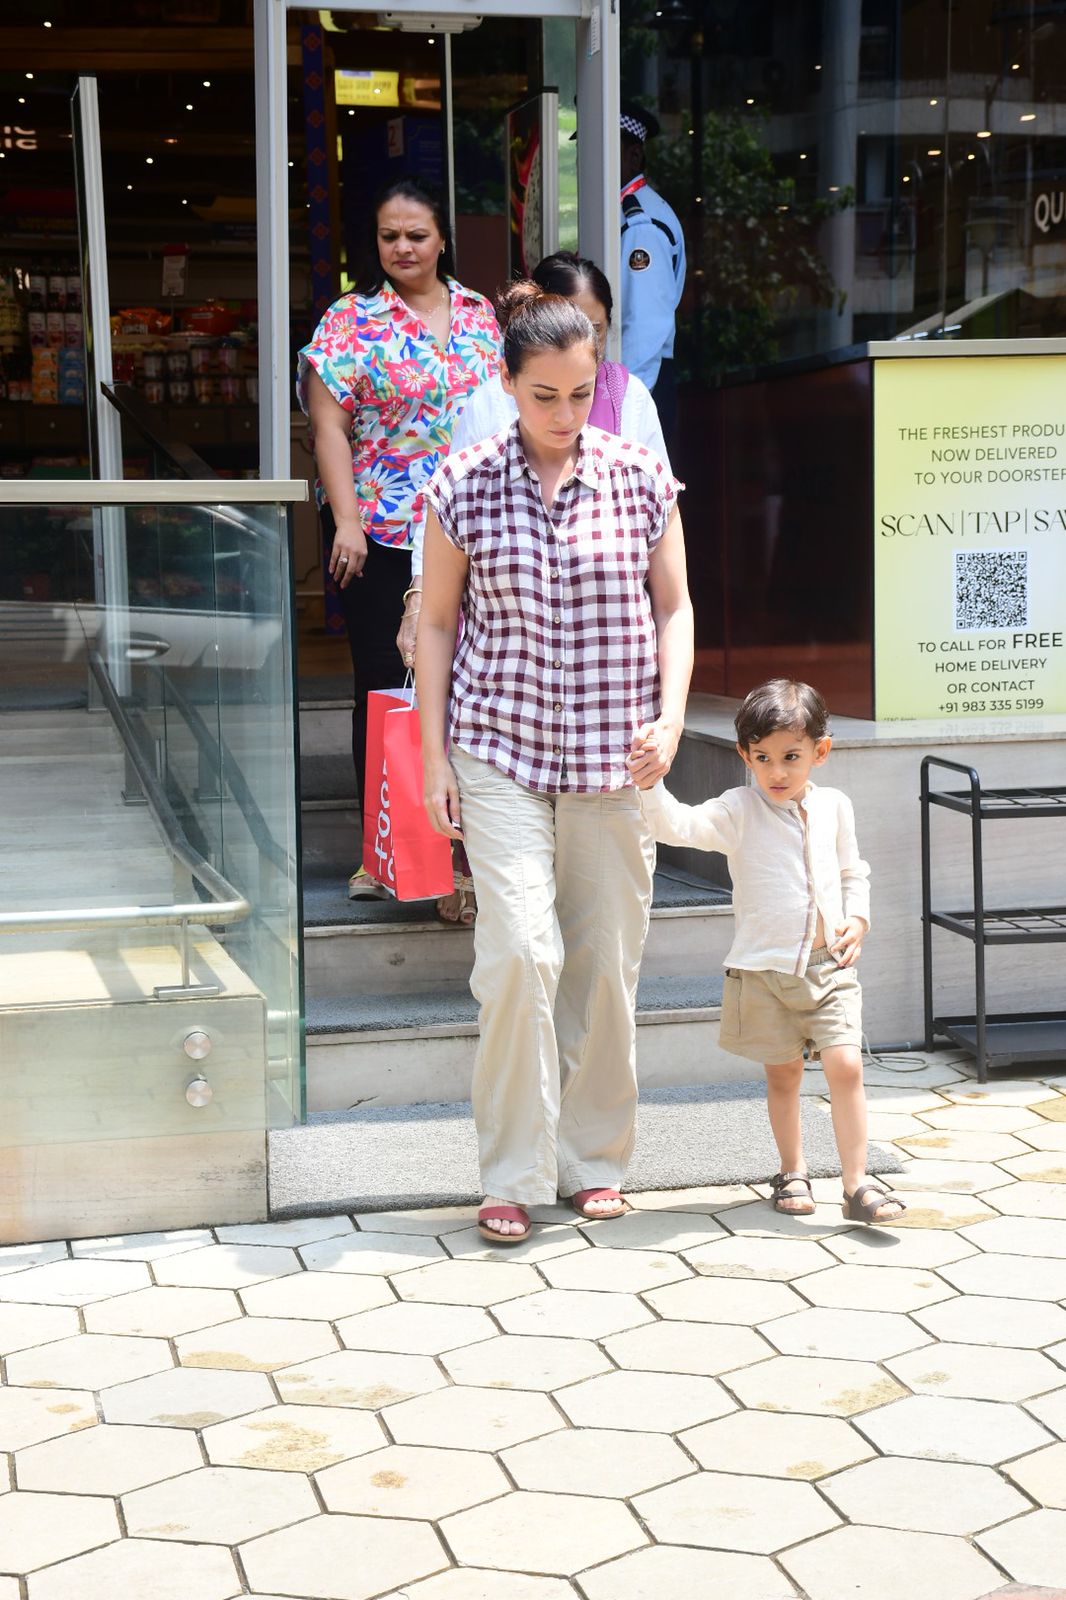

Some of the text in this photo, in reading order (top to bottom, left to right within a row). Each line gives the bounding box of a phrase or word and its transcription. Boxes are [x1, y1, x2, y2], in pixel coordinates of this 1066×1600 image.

[1034, 191, 1066, 233] QU
[898, 423, 1066, 441] THE FRESHEST PRODU
[931, 446, 1058, 462] NOW DELIVERED
[914, 472, 936, 485] TO
[940, 470, 983, 484] YOUR
[1033, 509, 1066, 533] SA
[917, 632, 1063, 653] TO CALL FOR FREE
[935, 658, 1048, 673] HOME DELIVERY
[946, 680, 1035, 694] OR CONTACT
[938, 698, 1045, 713] +91 983 335 5199
